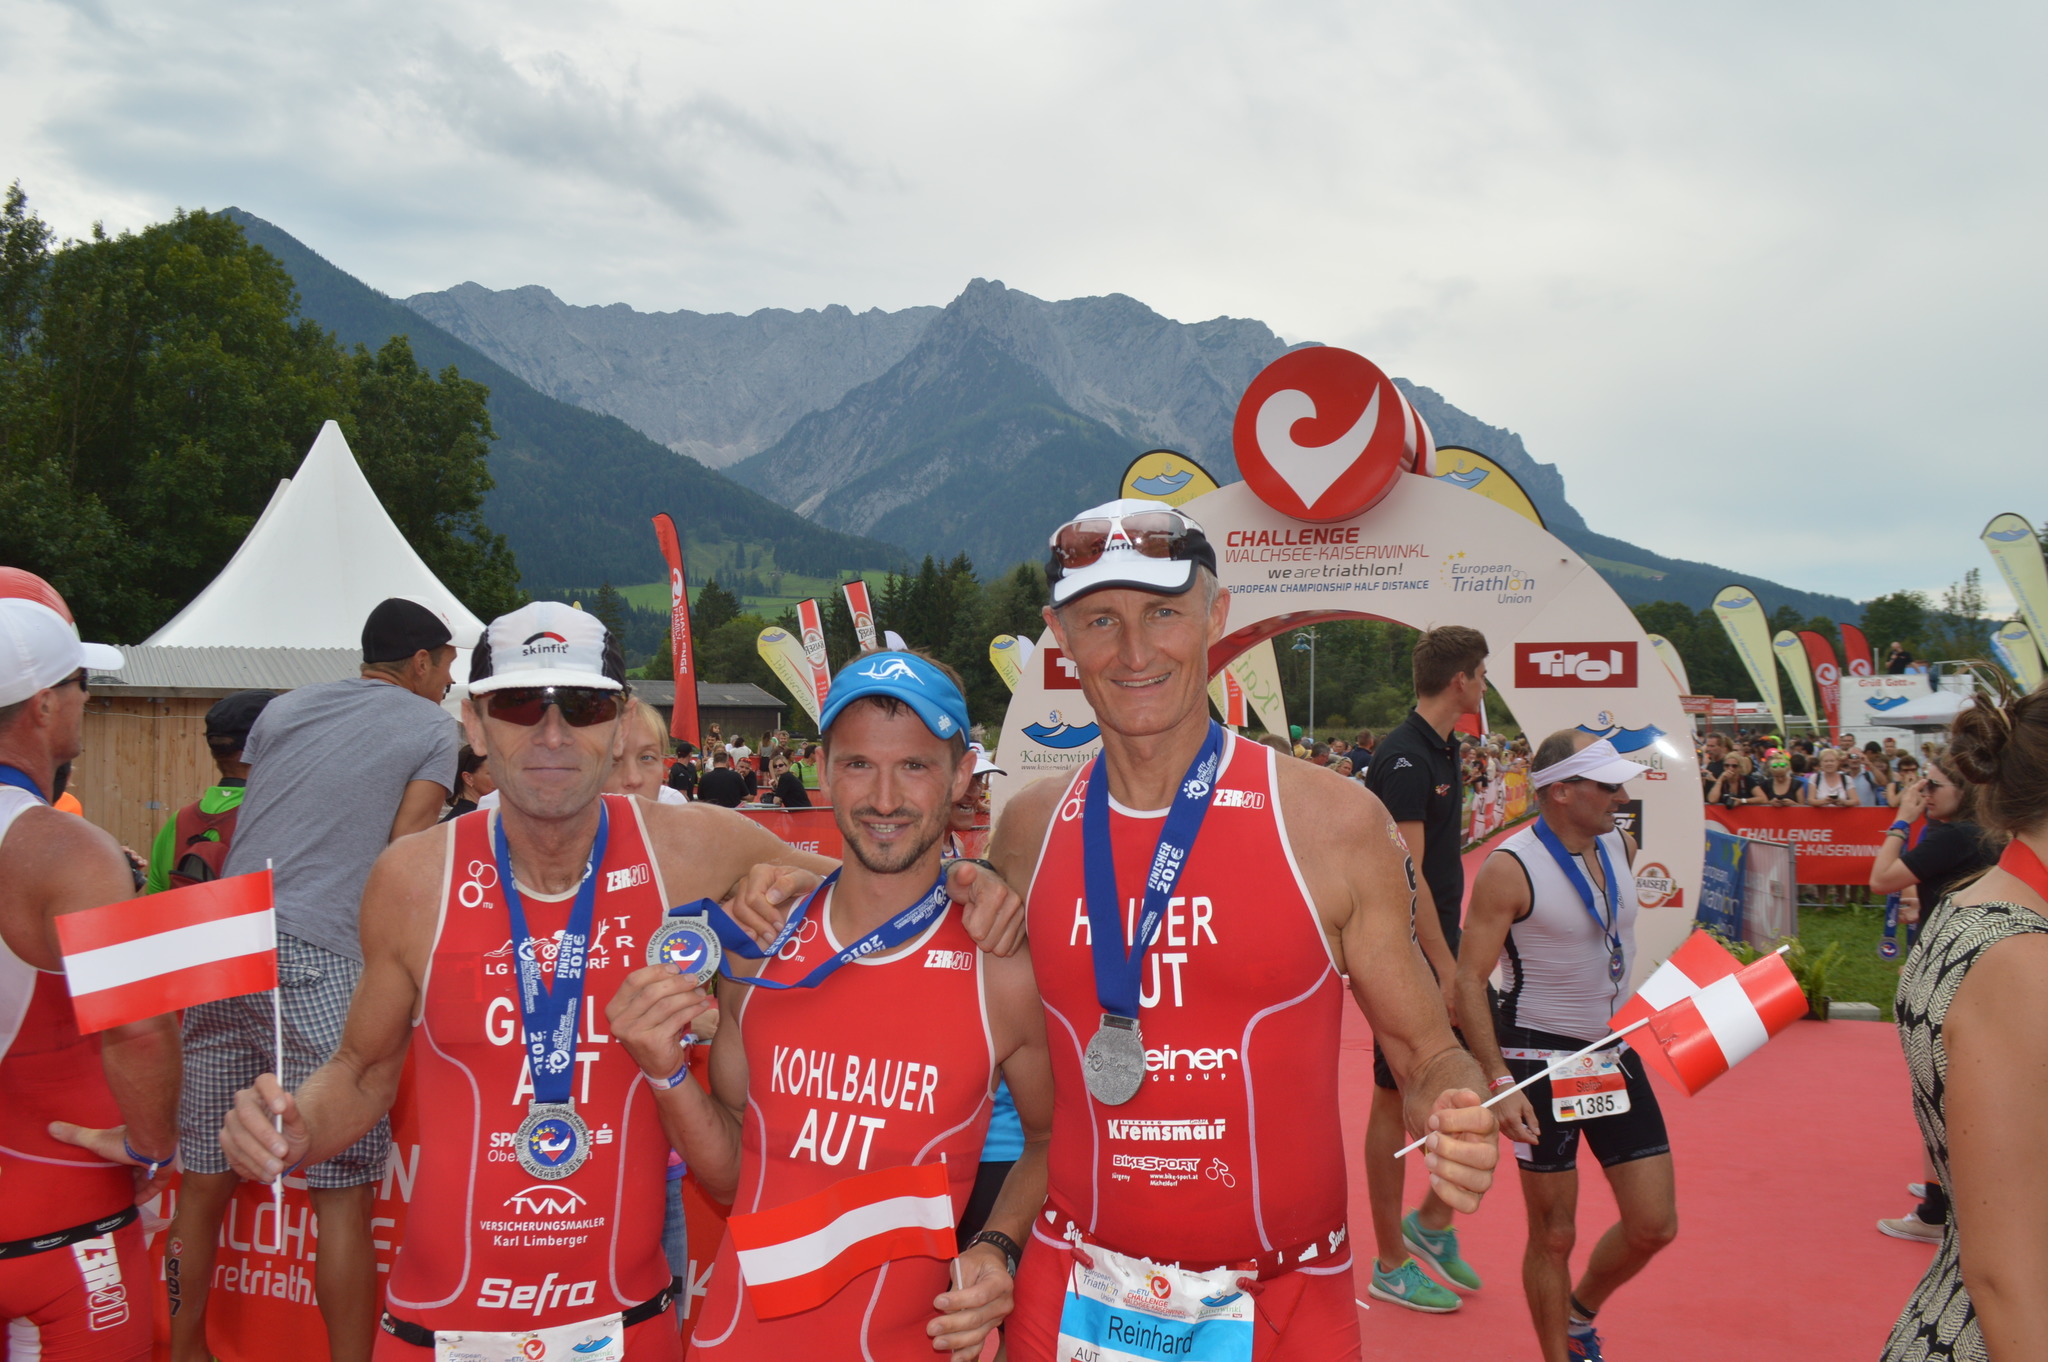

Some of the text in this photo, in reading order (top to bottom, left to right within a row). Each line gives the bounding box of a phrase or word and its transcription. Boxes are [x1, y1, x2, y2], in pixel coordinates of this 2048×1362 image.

[1227, 527, 1360, 547] CHALLENGE
[1226, 544, 1430, 562] WALCHSEE-KAISERWINKL
[1451, 564, 1512, 577] European
[1228, 580, 1429, 593] EUROPEAN CHAMPIONSHIP HALF DISTANCE
[1452, 576, 1535, 592] Triathlon
[1497, 593, 1532, 604] Union
[522, 644, 567, 657] skinfit
[1529, 650, 1623, 681] Tirol
[1737, 828, 1832, 843] CHALLENGE
[1148, 841, 1173, 889] FINISHER
[1070, 896, 1218, 947] HIER
[557, 933, 574, 979] FINISHER
[485, 963, 508, 975] LG
[1139, 952, 1188, 1008] UT
[512, 1051, 600, 1106] AT
[771, 1045, 938, 1114] KOHLBAUER
[1576, 1095, 1614, 1115] 1385
[790, 1108, 886, 1171] AUT
[1107, 1119, 1226, 1141] Kremsmair
[511, 1197, 576, 1214] TVM
[480, 1217, 605, 1231] VERSICHERUNGSMAKLER
[493, 1235, 588, 1248] Karl Limberger
[477, 1272, 597, 1316] Sefra
[1127, 1292, 1169, 1308] CHALLENGE
[1108, 1316, 1195, 1355] Reinhard
[1074, 1347, 1100, 1362] AUT
